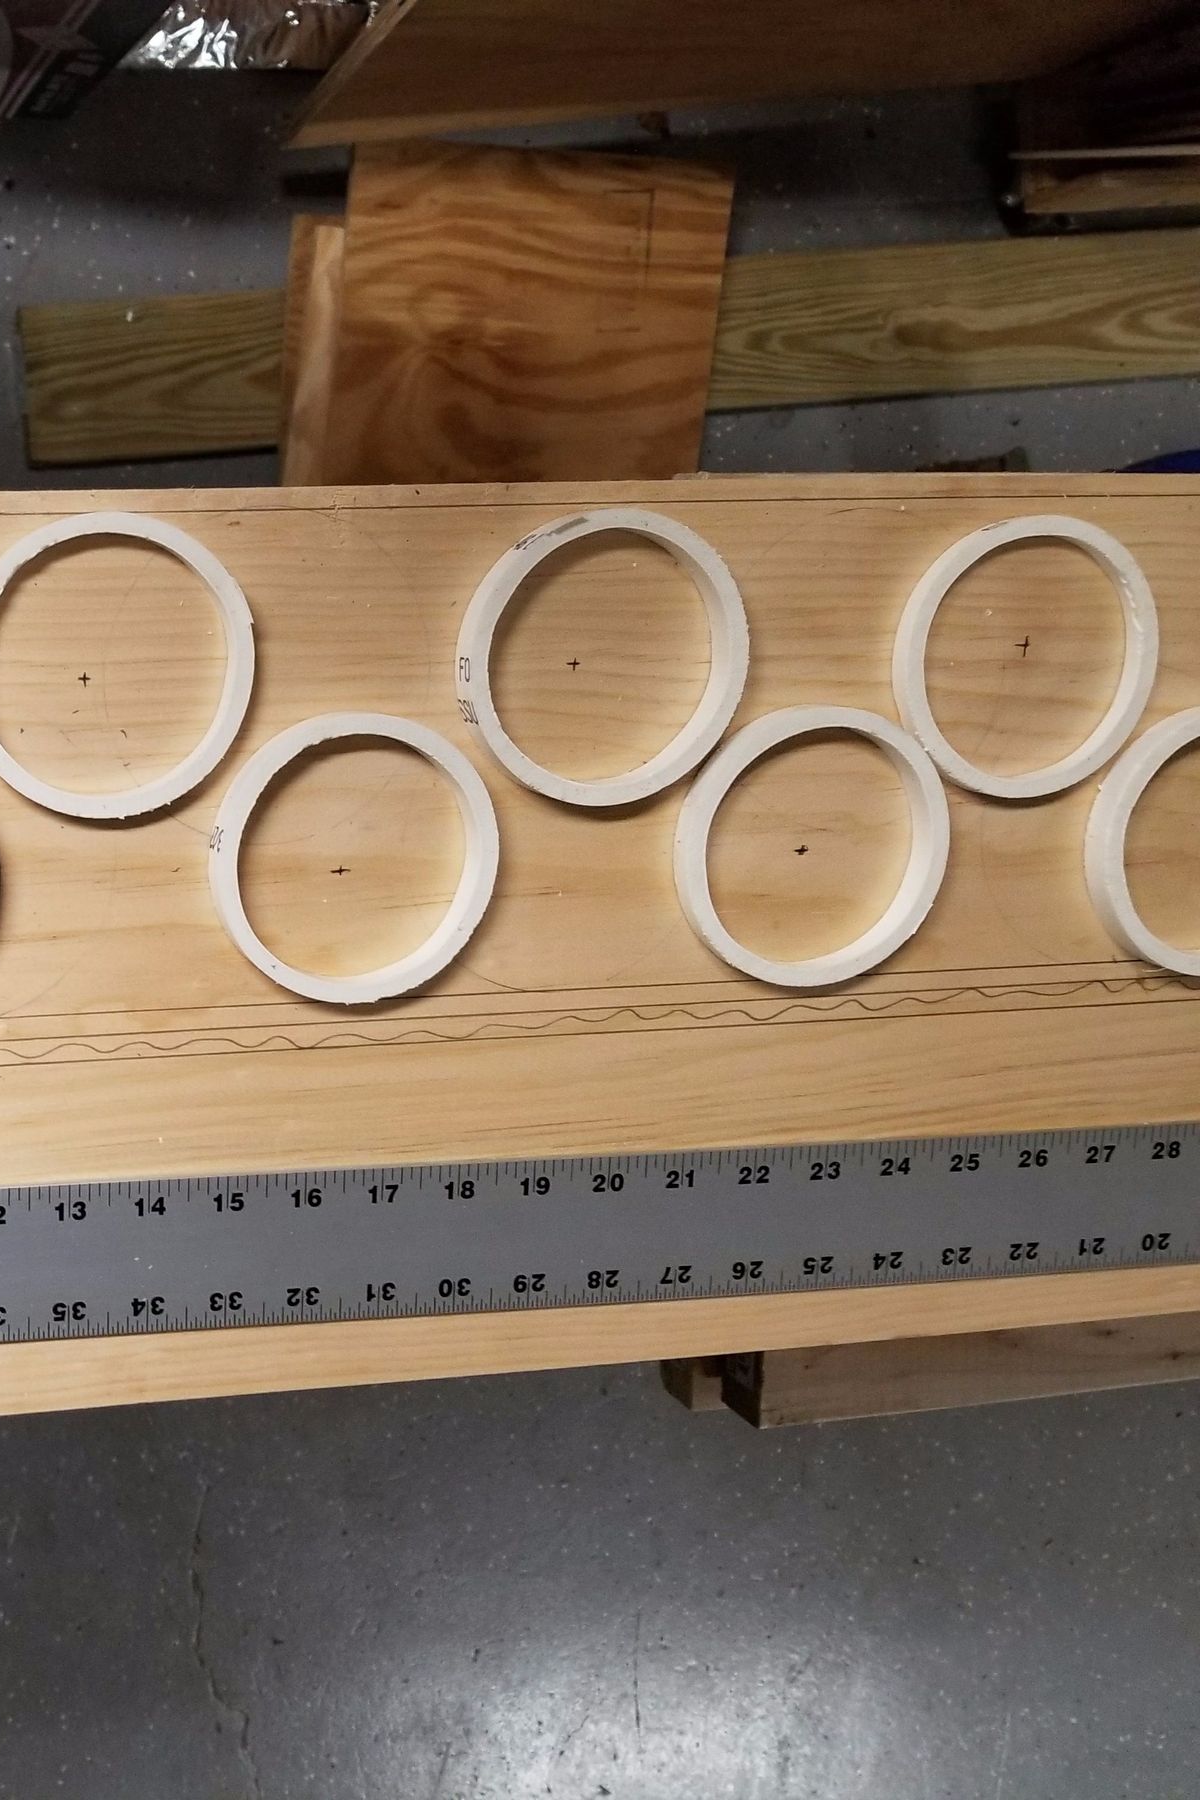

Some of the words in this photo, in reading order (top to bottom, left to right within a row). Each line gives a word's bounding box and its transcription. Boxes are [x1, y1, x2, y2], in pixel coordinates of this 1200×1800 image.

[55, 1200, 87, 1222] 13
[134, 1196, 166, 1217] 14
[213, 1191, 245, 1212] 15
[291, 1187, 322, 1209] 16
[368, 1183, 398, 1204] 17
[444, 1179, 475, 1200] 18
[520, 1175, 551, 1197] 19
[592, 1172, 624, 1192] 20
[665, 1168, 696, 1189] 21
[738, 1165, 770, 1185] 22
[809, 1160, 841, 1180] 23
[879, 1156, 911, 1176] 24
[950, 1152, 981, 1173] 25
[1018, 1148, 1049, 1169] 26
[1085, 1144, 1116, 1165] 27
[1152, 1141, 1181, 1161] 28
[1009, 1242, 1040, 1262] 22
[1078, 1237, 1106, 1256] 21
[1141, 1232, 1171, 1252] 20
[803, 1255, 834, 1276] 25
[873, 1251, 904, 1271] 24
[941, 1246, 972, 1266] 23
[587, 1269, 620, 1290] 28
[660, 1265, 693, 1286] 27
[732, 1260, 764, 1281] 26
[366, 1282, 397, 1302] 31
[438, 1278, 472, 1298] 30
[513, 1273, 547, 1293] 29
[131, 1296, 166, 1317] 34
[209, 1291, 243, 1312] 33
[286, 1286, 321, 1307] 32
[52, 1301, 87, 1322] 35
